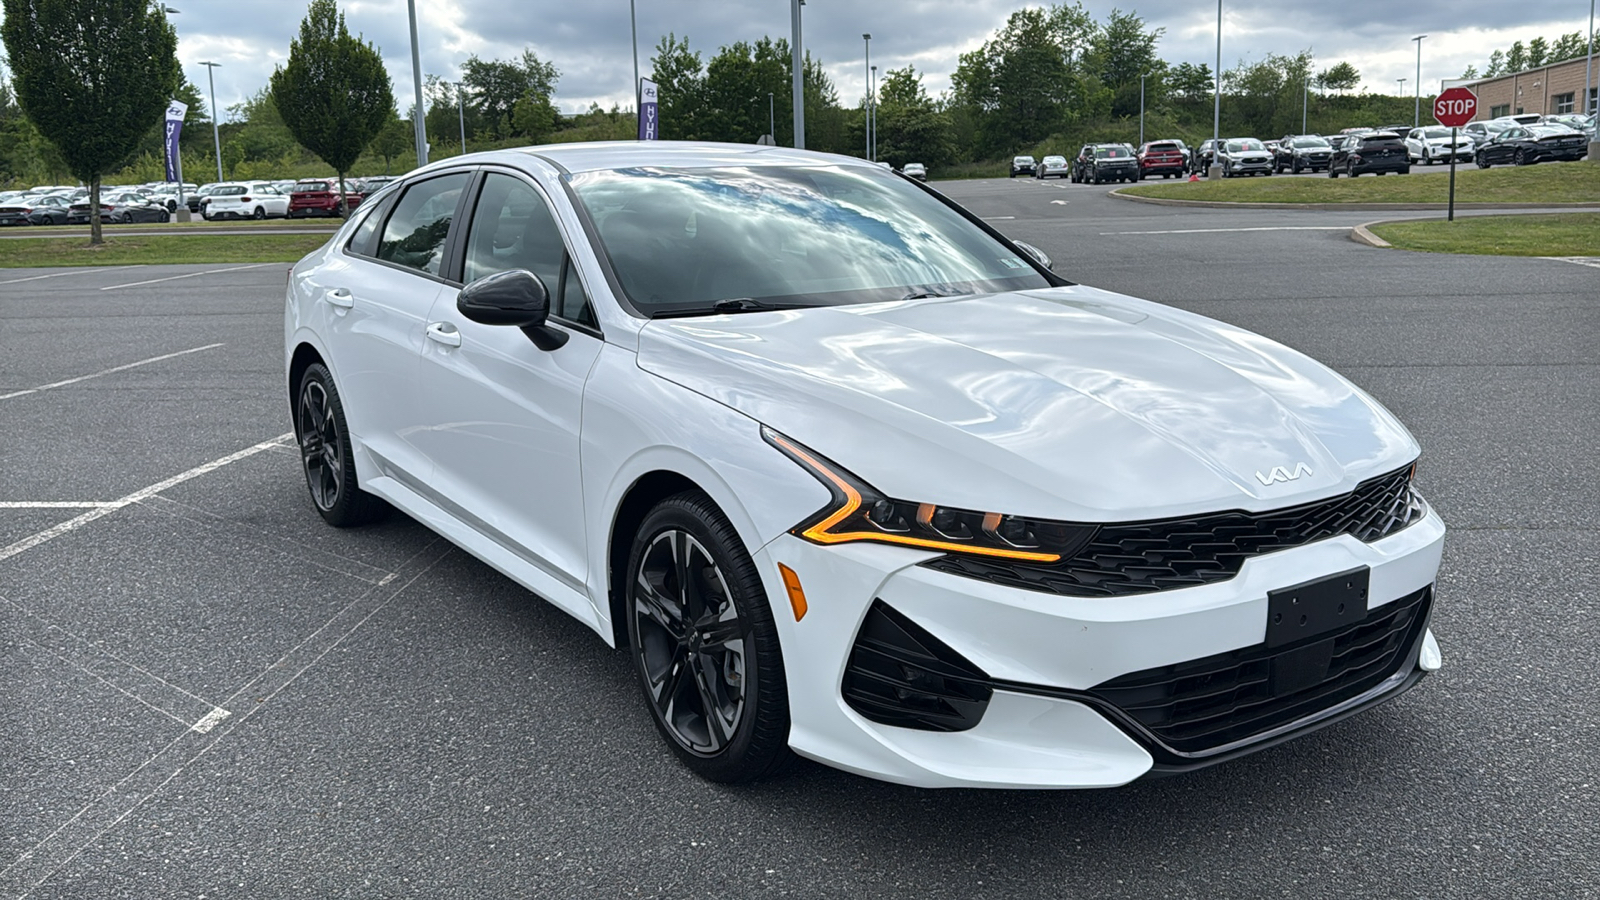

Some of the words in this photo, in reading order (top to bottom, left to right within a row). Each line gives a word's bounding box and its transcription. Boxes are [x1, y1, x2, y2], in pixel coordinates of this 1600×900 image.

[1436, 99, 1475, 116] STOP
[646, 105, 655, 140] HYUN
[1255, 462, 1313, 486] KIA
